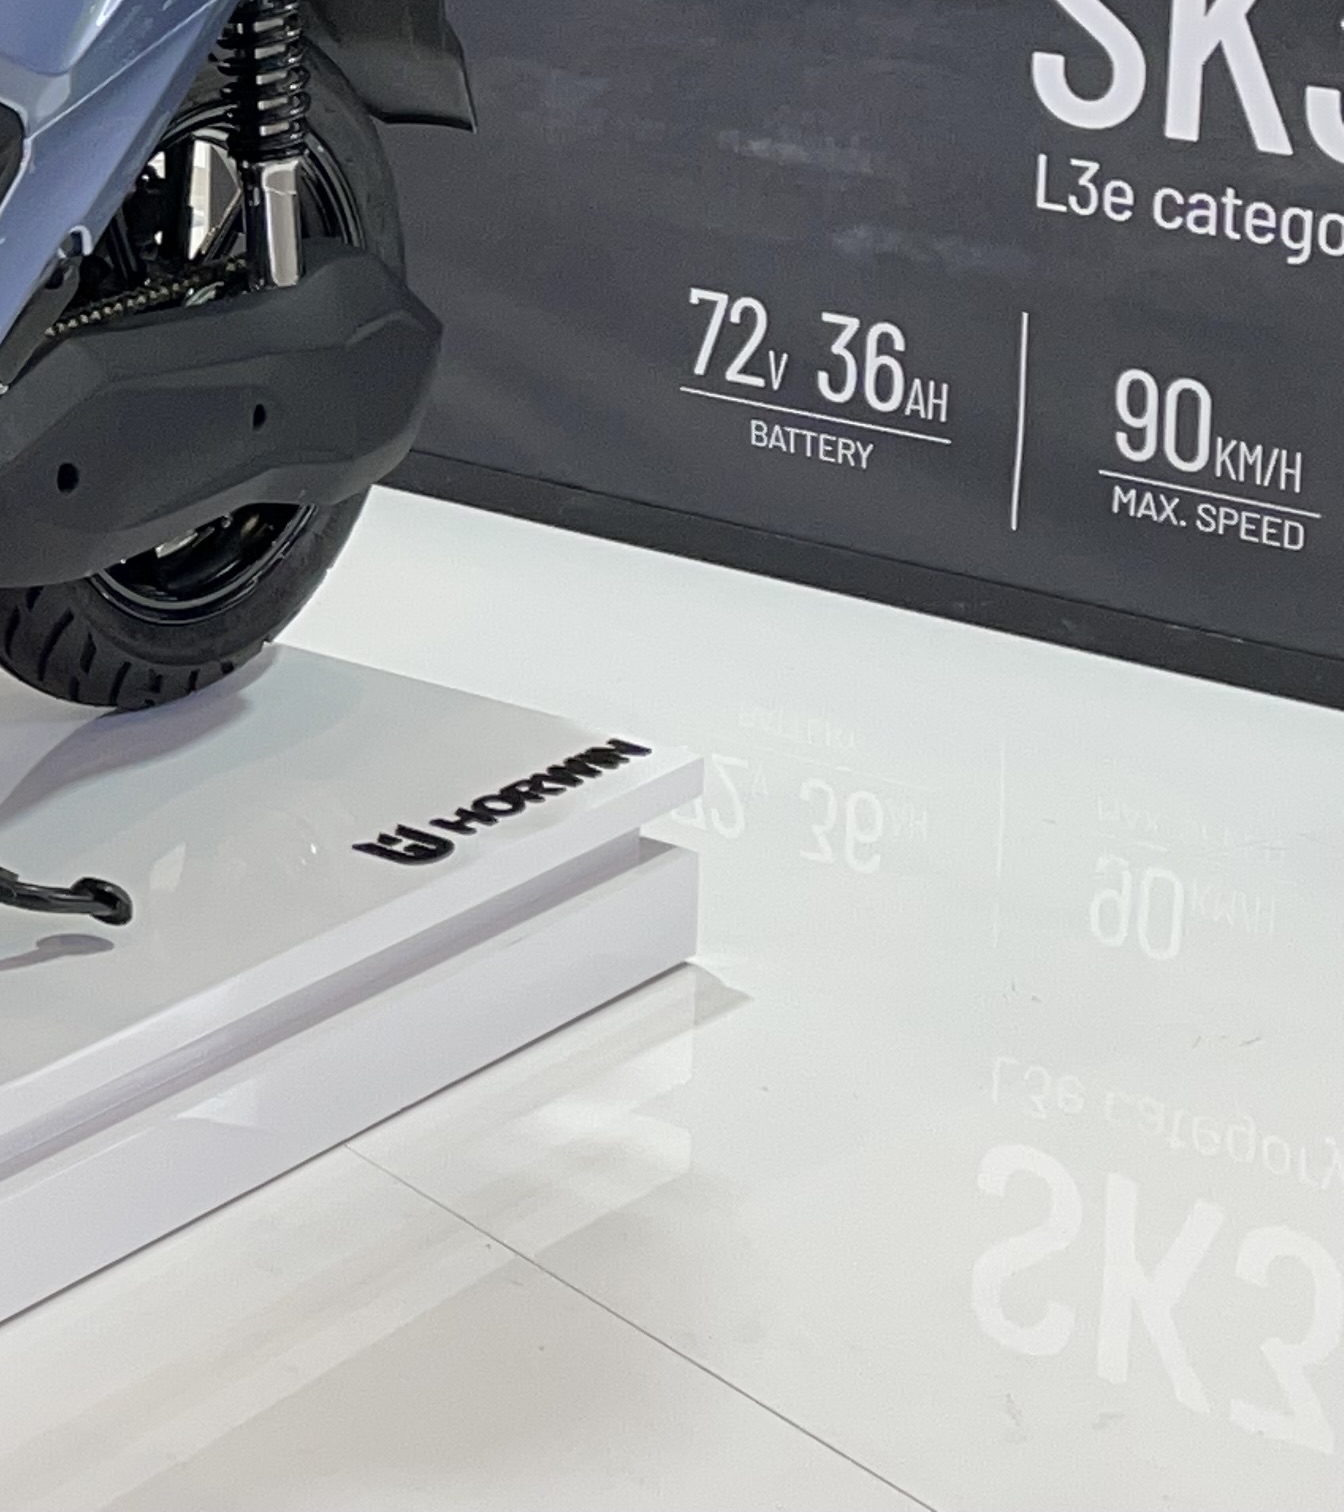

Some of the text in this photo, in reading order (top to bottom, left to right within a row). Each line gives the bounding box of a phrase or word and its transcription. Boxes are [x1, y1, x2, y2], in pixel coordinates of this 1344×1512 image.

[1035, 153, 1344, 265] L3e catego
[750, 419, 874, 469] BATTERY
[1111, 484, 1305, 551] MAX. SPEED
[429, 738, 653, 835] HORWIN
